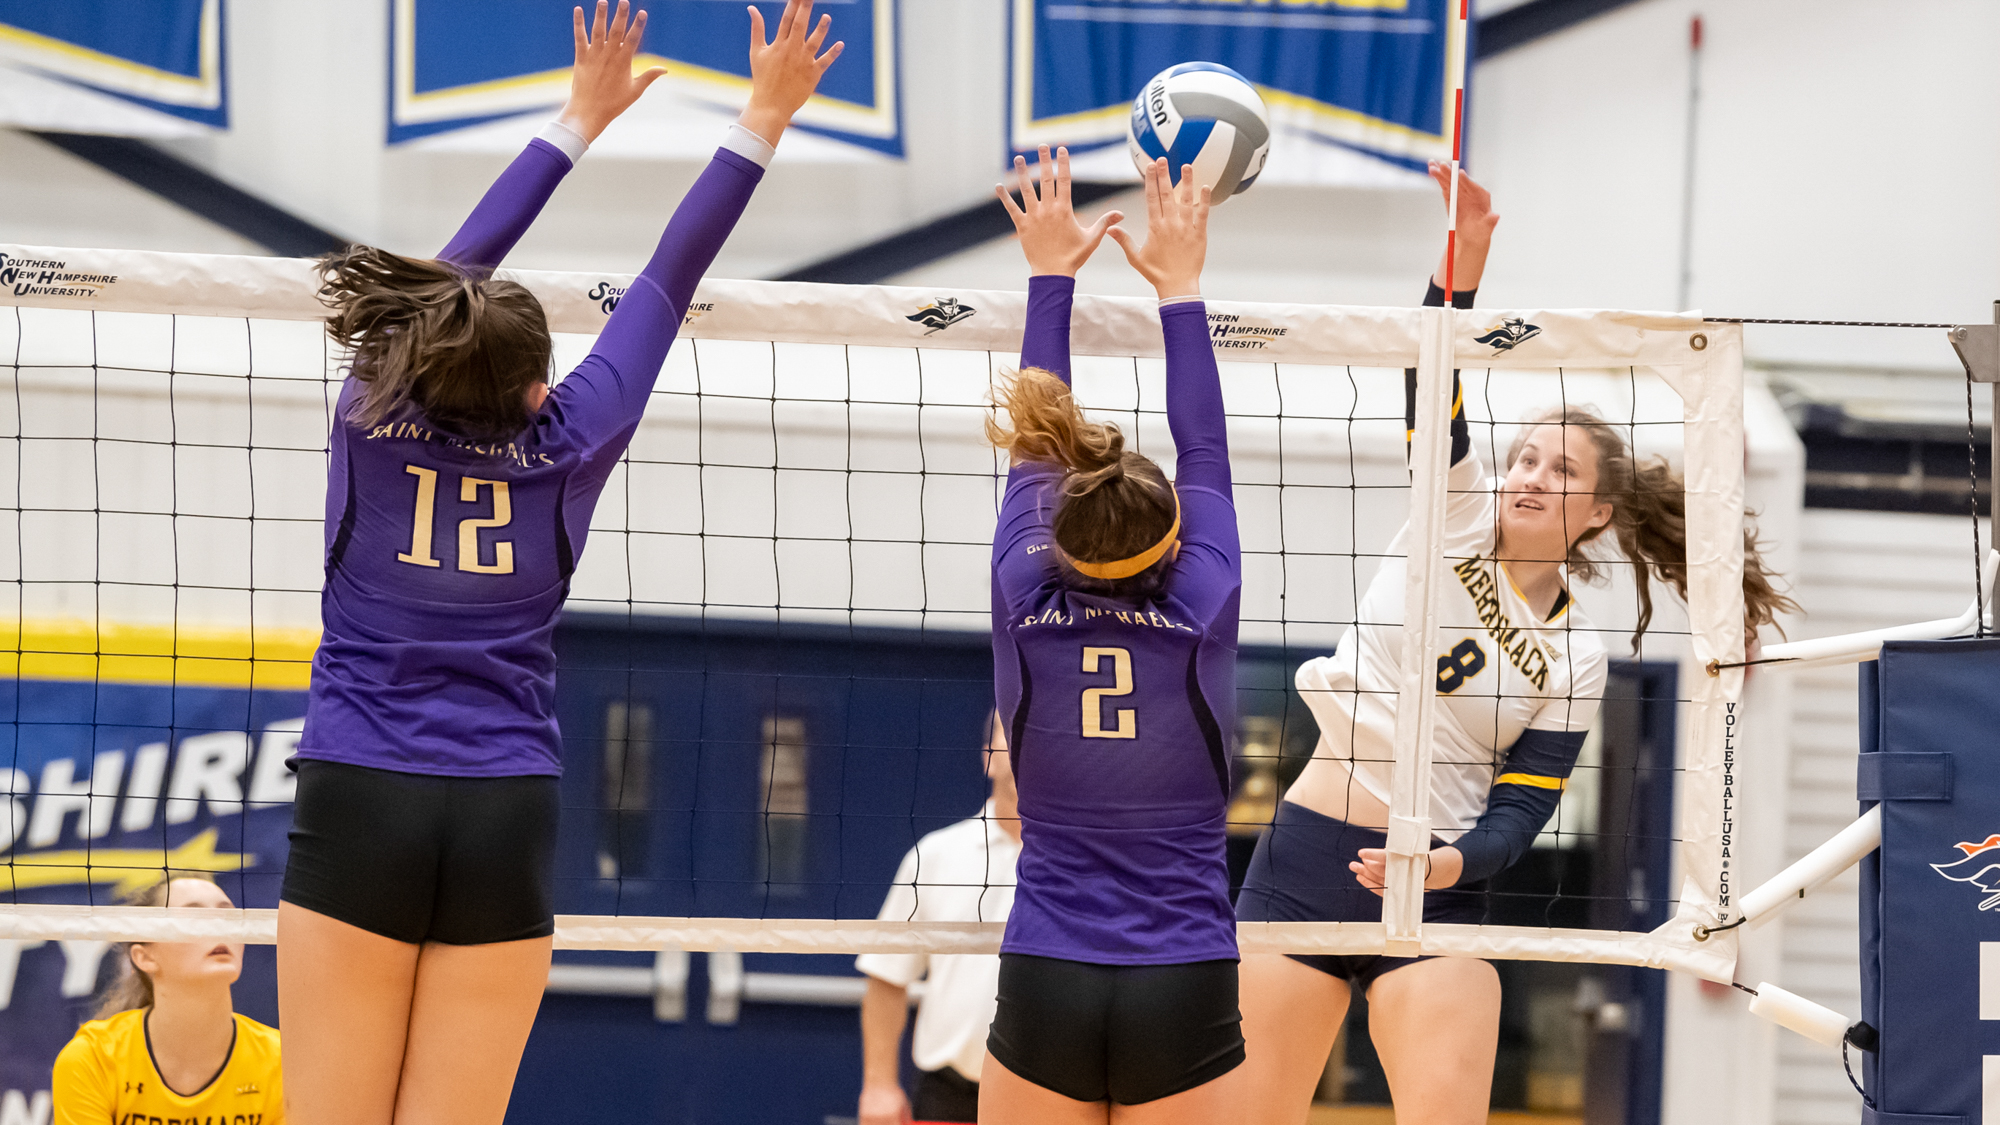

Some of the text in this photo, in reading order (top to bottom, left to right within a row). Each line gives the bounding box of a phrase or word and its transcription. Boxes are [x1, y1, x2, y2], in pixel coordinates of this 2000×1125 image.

[1151, 79, 1167, 127] olten
[1, 267, 118, 287] NEW HAMPSHIRE
[14, 283, 95, 297] UNIVERSITY
[1206, 314, 1240, 323] HERN
[1213, 325, 1287, 338] HAMPSHIRE
[1211, 340, 1266, 349] IVERSITY
[397, 464, 515, 575] 12
[1436, 637, 1487, 695] 8
[1081, 646, 1137, 740] 2
